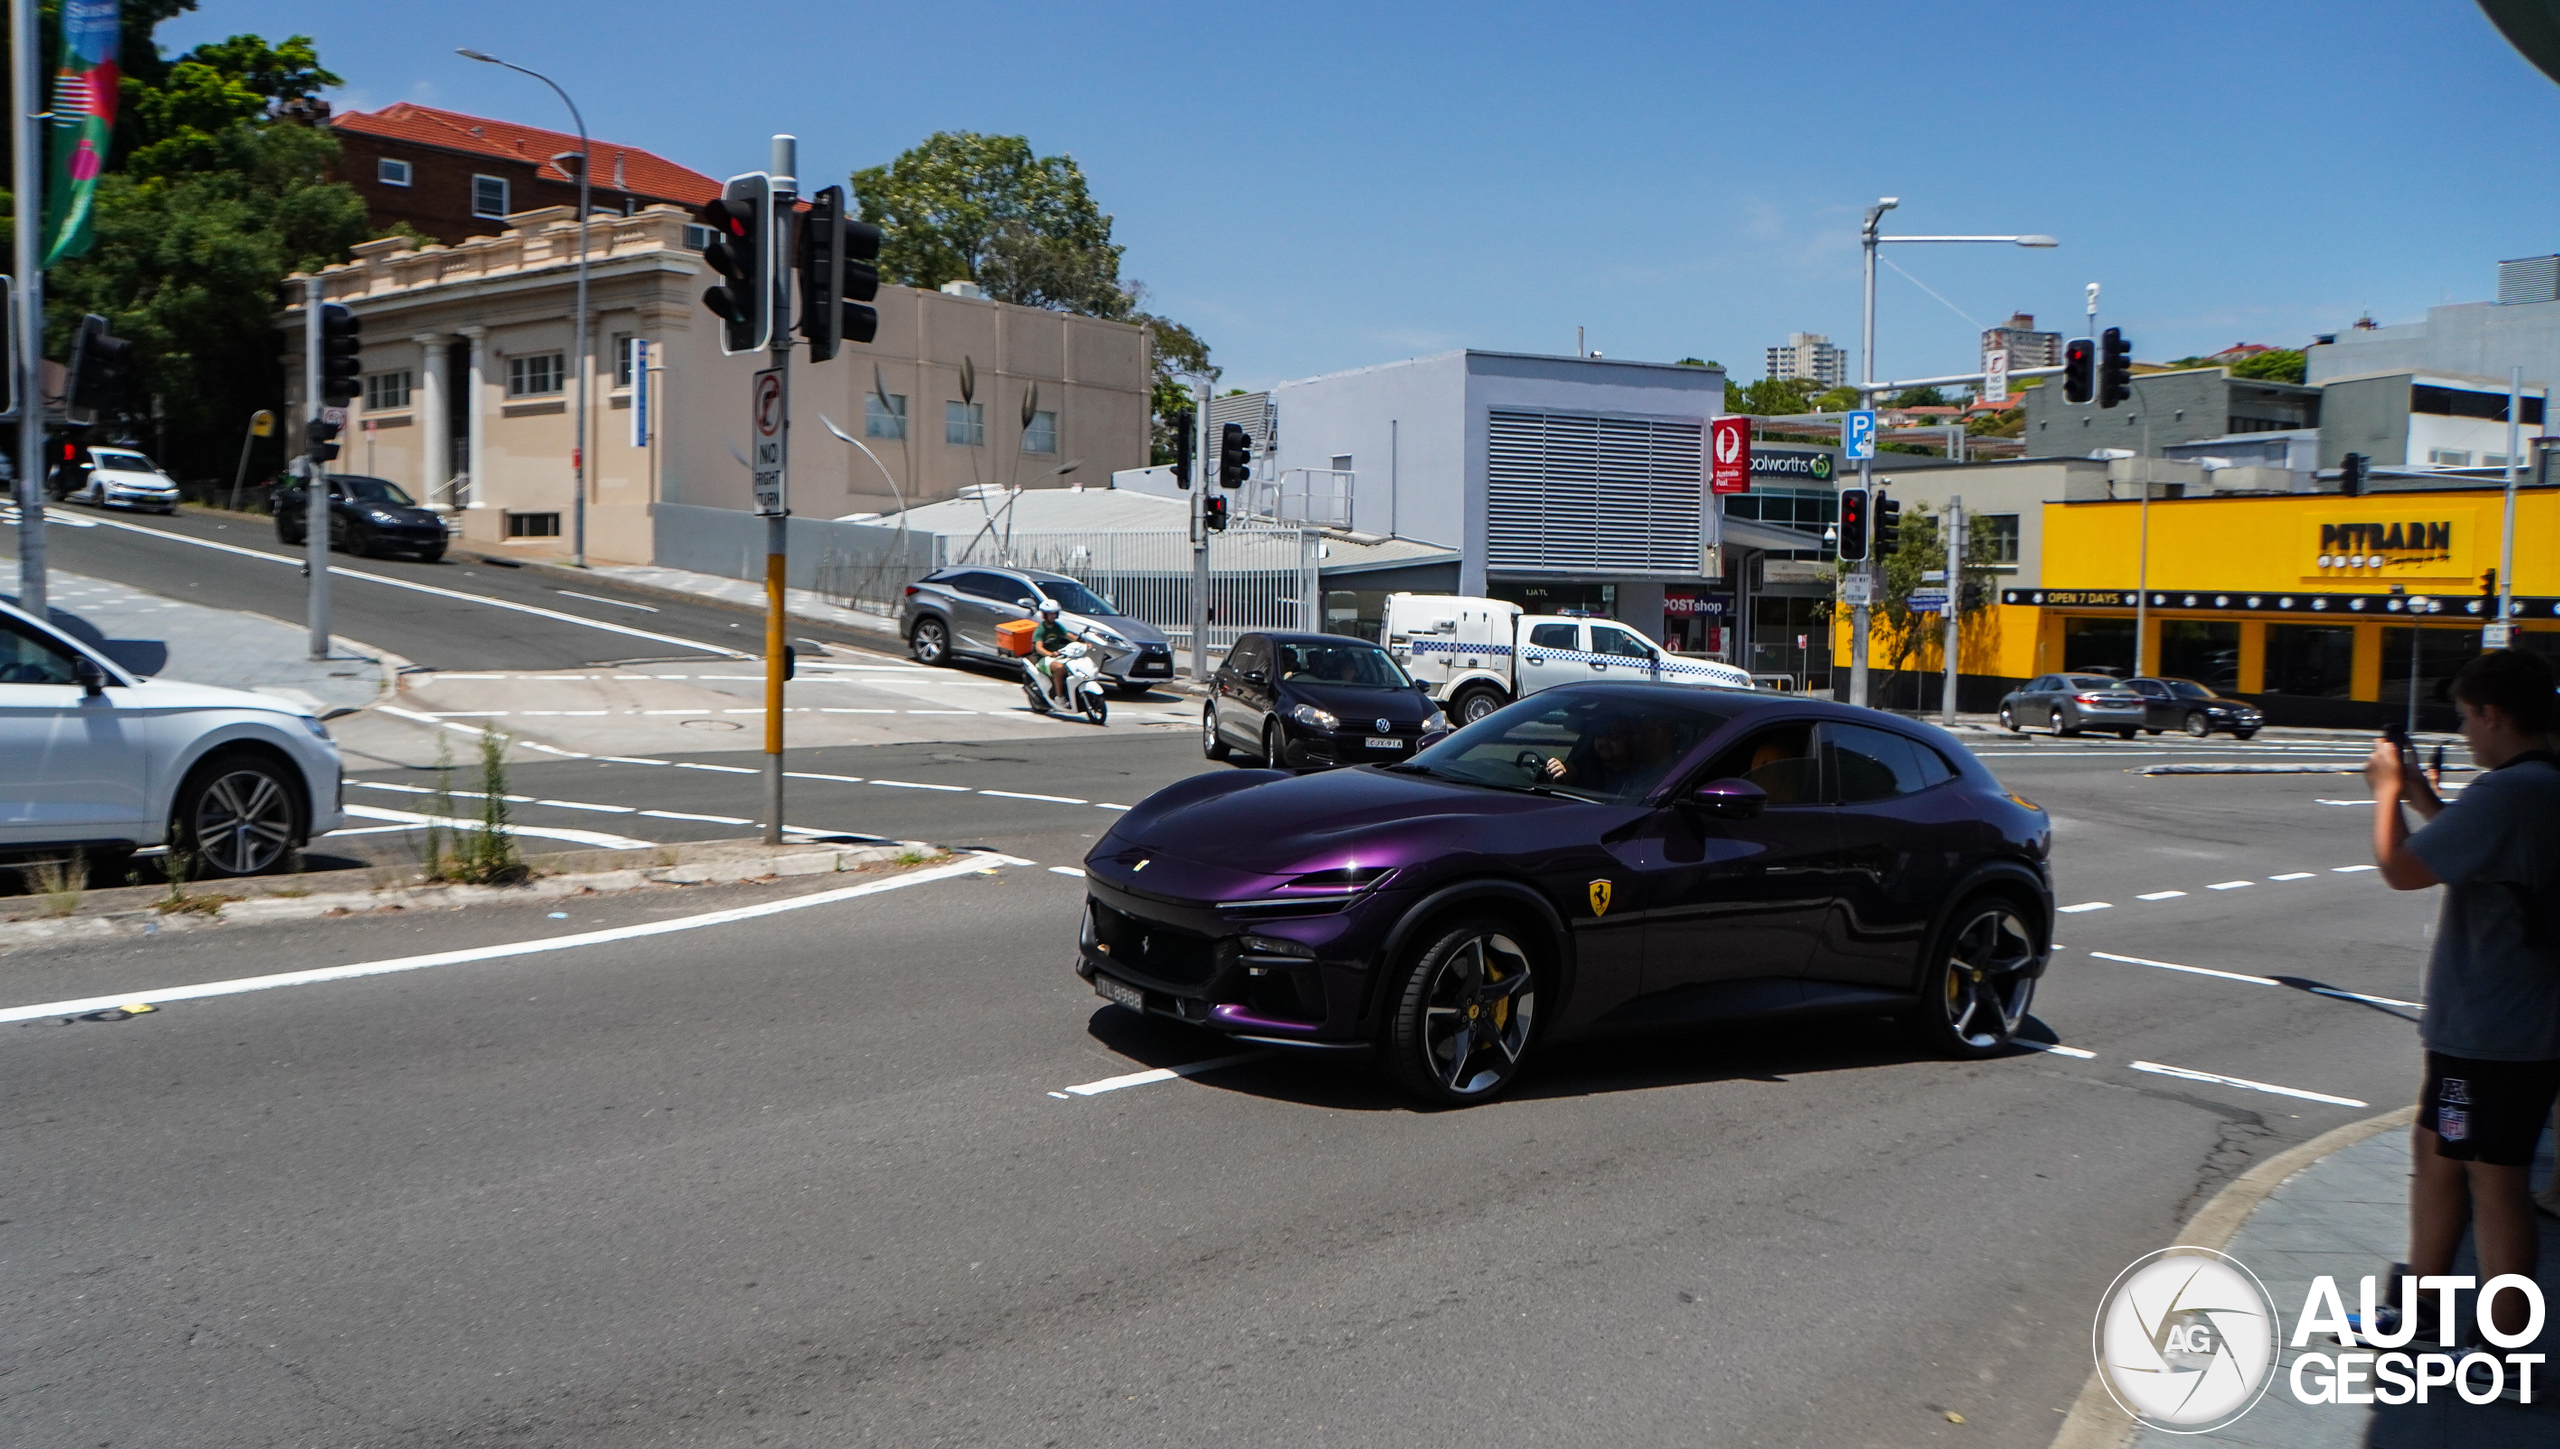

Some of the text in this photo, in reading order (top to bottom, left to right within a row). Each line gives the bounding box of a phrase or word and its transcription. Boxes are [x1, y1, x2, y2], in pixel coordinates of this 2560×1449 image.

[1853, 415, 1870, 439] P
[760, 443, 779, 464] NO
[755, 470, 781, 486] RIGHT
[1716, 468, 1739, 478] Australia
[1716, 479, 1729, 487] Post
[756, 492, 779, 507] TURN
[2320, 521, 2450, 550] PETBARN
[2048, 592, 2119, 604] OPEN 7 DAYS
